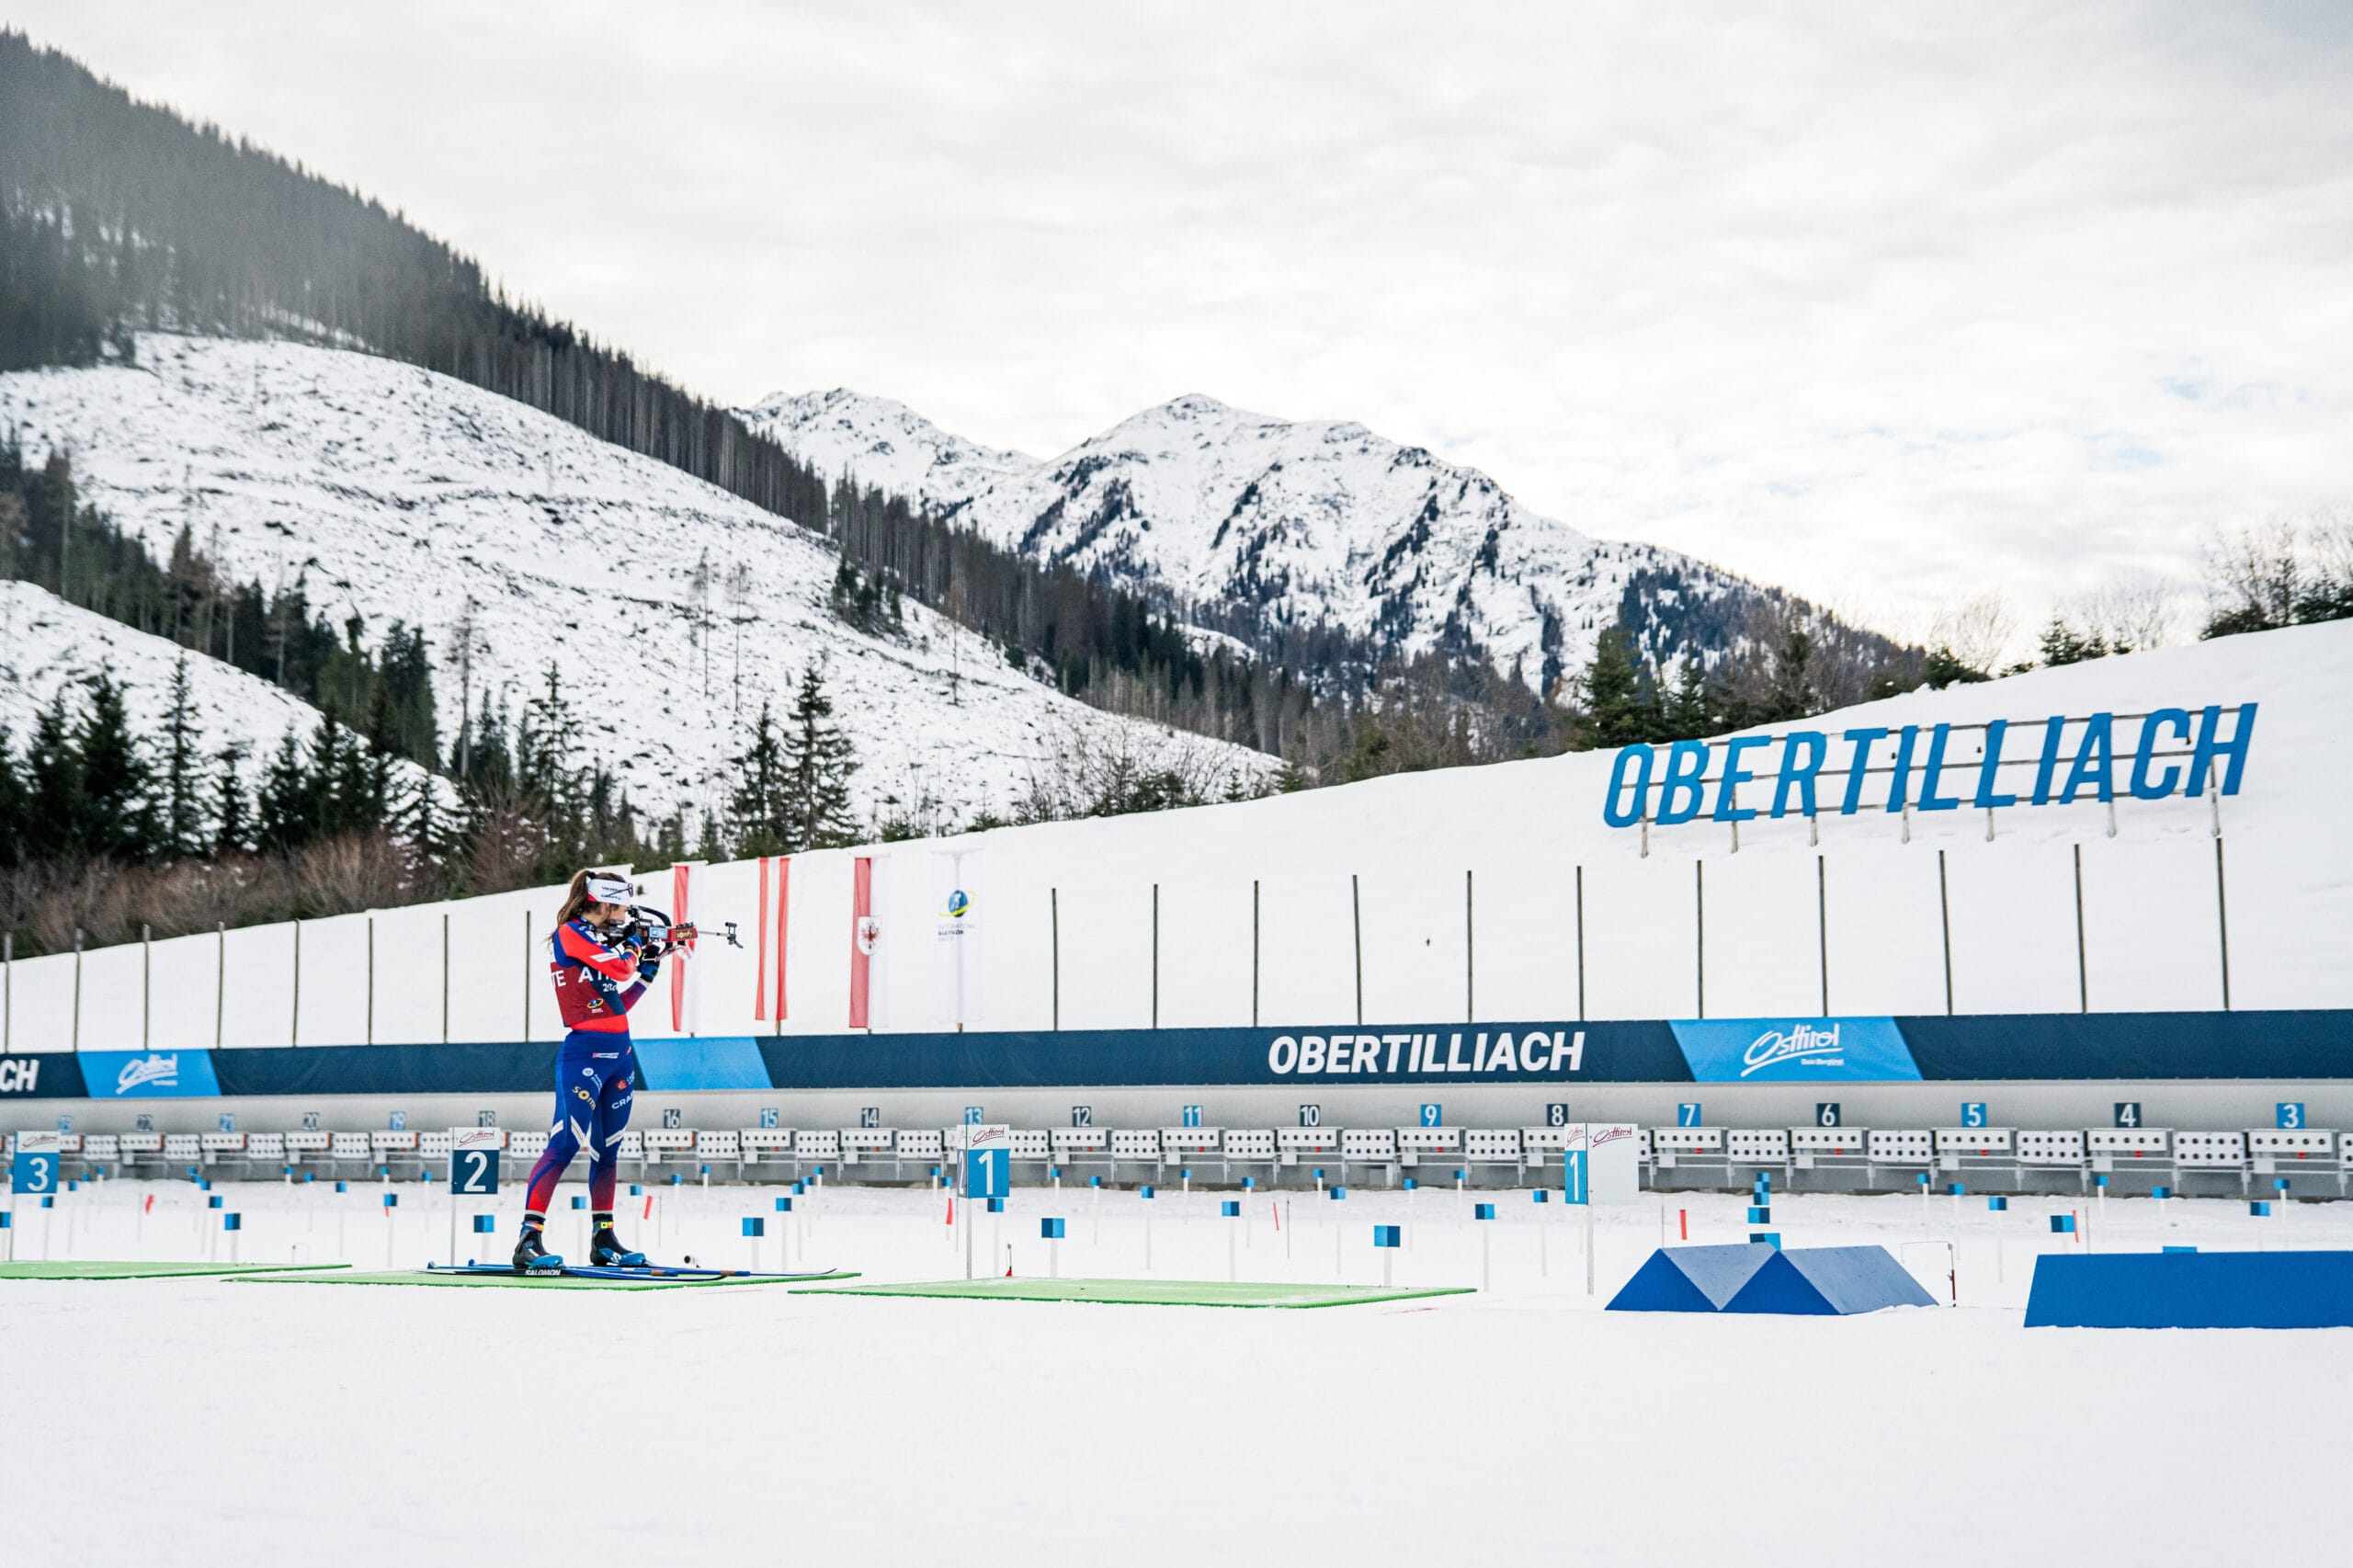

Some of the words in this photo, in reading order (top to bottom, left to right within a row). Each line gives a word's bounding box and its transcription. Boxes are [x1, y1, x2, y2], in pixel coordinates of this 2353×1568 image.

[1604, 702, 2259, 828] OBERTILLIACH
[1268, 1031, 1586, 1074] OBERTILLIACH
[1743, 1022, 1841, 1068] Osttirol
[479, 1110, 494, 1127] 18
[665, 1110, 680, 1129] 16
[762, 1108, 778, 1128] 15
[862, 1108, 879, 1127] 14
[966, 1108, 983, 1125] 13
[1074, 1107, 1091, 1127] 12
[1185, 1106, 1202, 1127] 11
[1301, 1106, 1320, 1127] 10
[1425, 1105, 1437, 1126] 9
[1552, 1105, 1563, 1126] 8
[1683, 1104, 1696, 1126] 7
[1822, 1104, 1836, 1126] 6
[1967, 1104, 1982, 1127] 5
[2120, 1104, 2136, 1127] 4
[2283, 1104, 2298, 1128] 3
[1593, 1127, 1632, 1145] Osttirol
[27, 1157, 49, 1192] 3
[463, 1151, 488, 1192] 2
[978, 1151, 993, 1195] 1
[1570, 1151, 1579, 1201] 1
